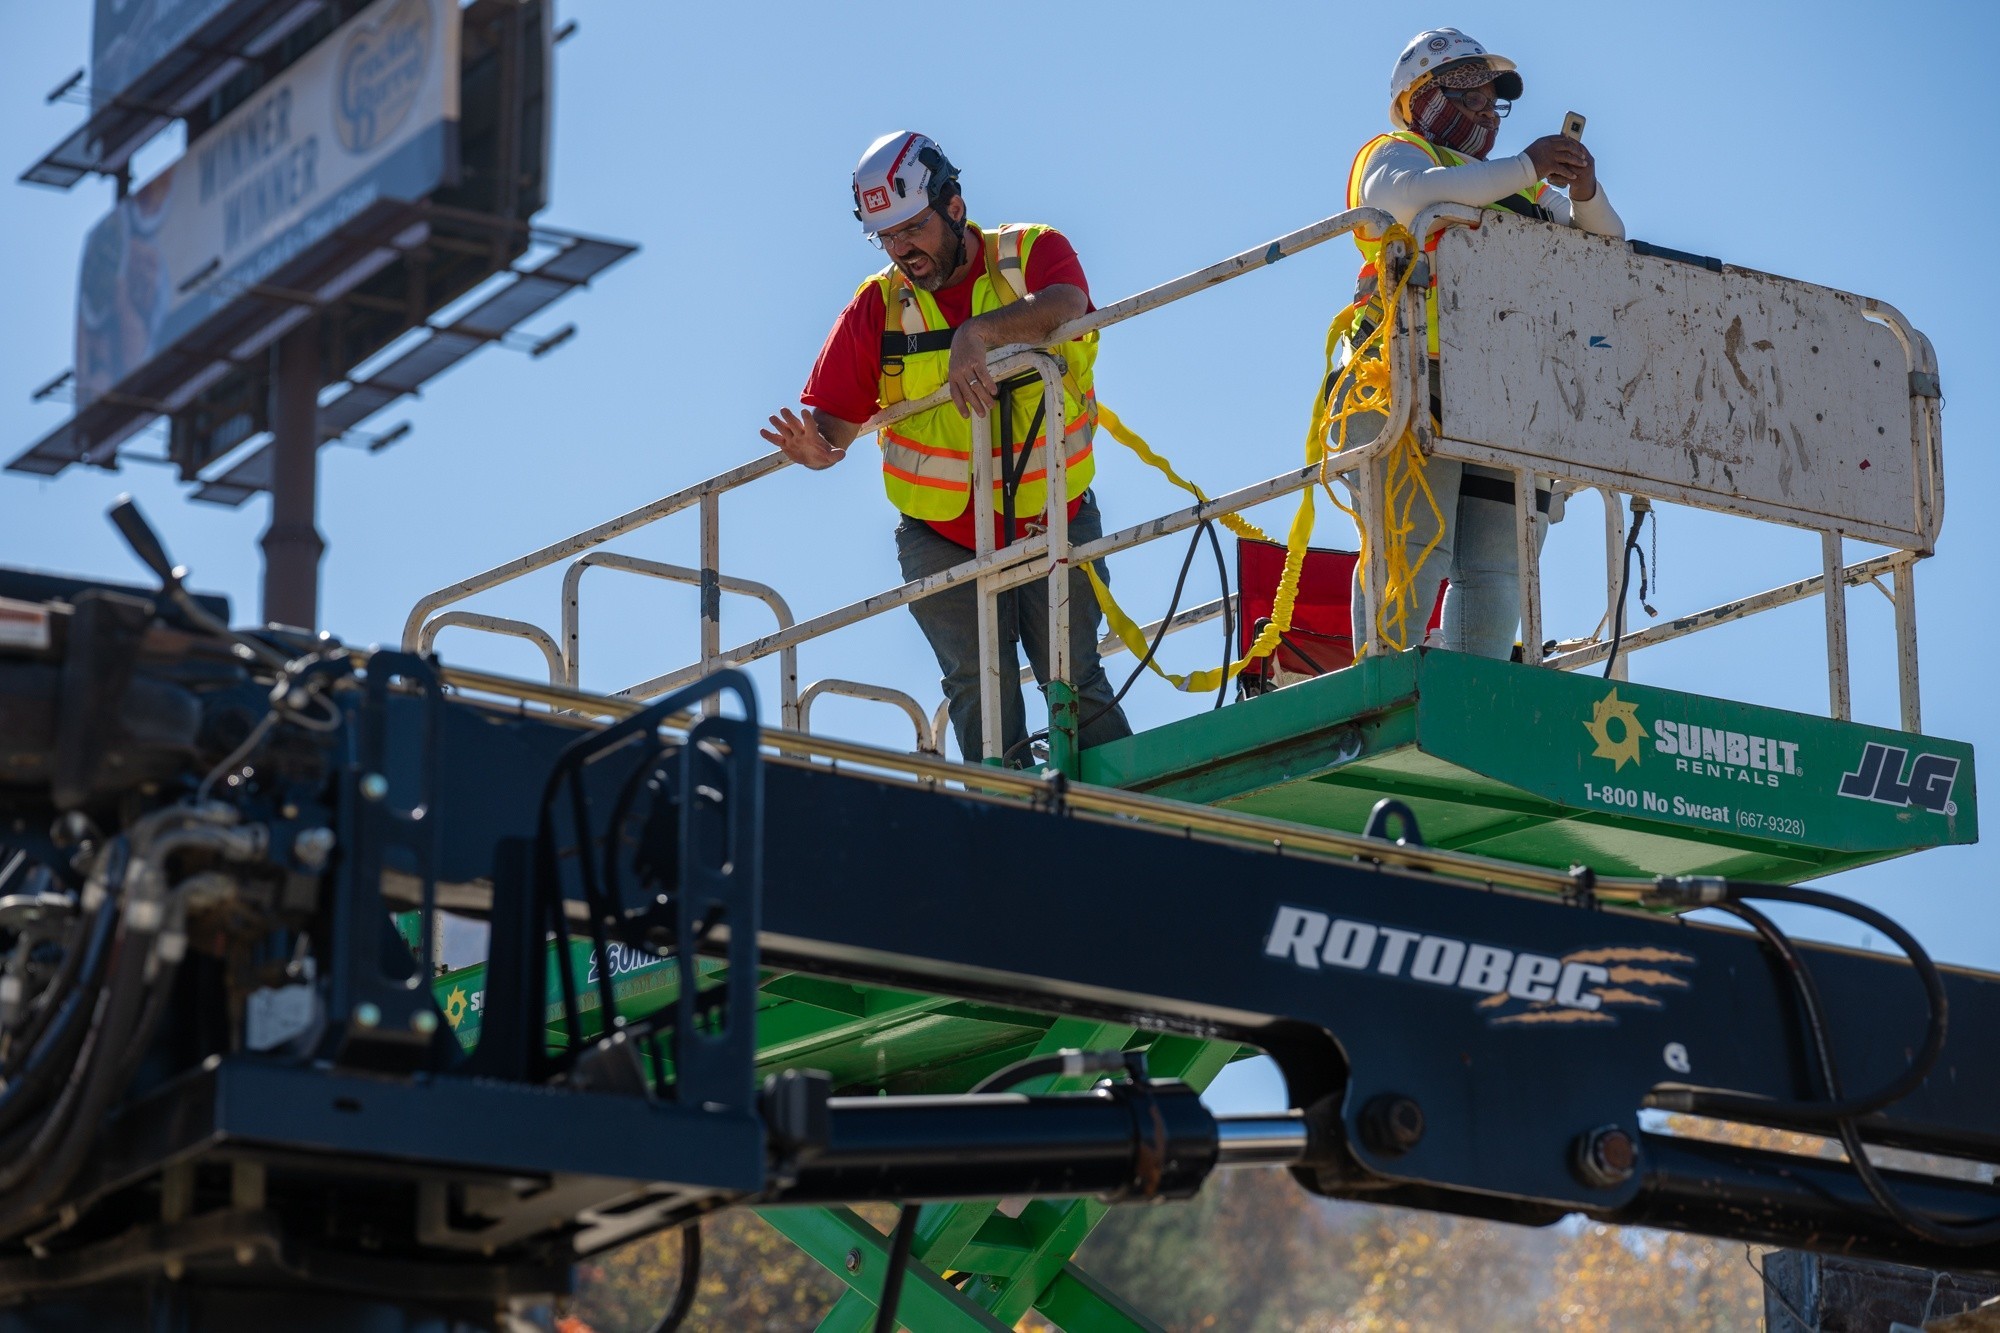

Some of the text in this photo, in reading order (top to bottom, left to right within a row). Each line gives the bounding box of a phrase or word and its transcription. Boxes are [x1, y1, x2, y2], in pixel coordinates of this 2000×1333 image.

[1655, 719, 1799, 776] SUNBELT
[1676, 758, 1780, 788] RENTALS
[1837, 741, 1961, 815] JLG
[1584, 783, 1805, 838] 1-800 No Sweat (667-9328)
